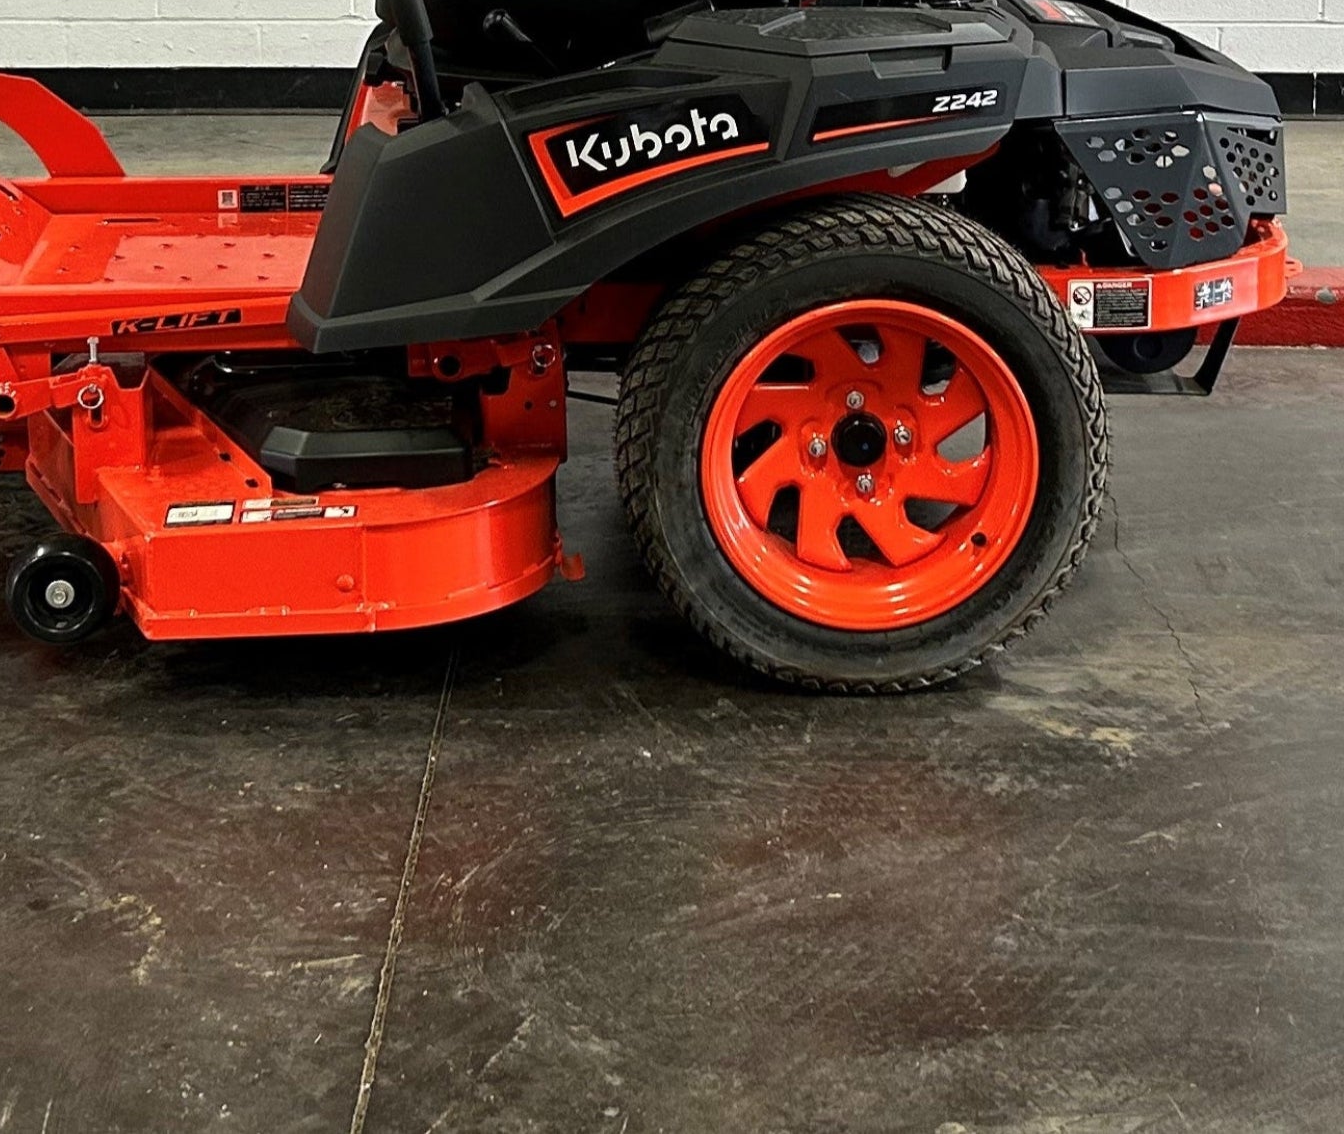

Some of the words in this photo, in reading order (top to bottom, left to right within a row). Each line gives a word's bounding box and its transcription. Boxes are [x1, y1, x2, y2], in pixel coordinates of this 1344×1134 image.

[931, 89, 998, 113] Z242
[565, 108, 739, 172] Kubota
[117, 309, 236, 334] K-LIFT
